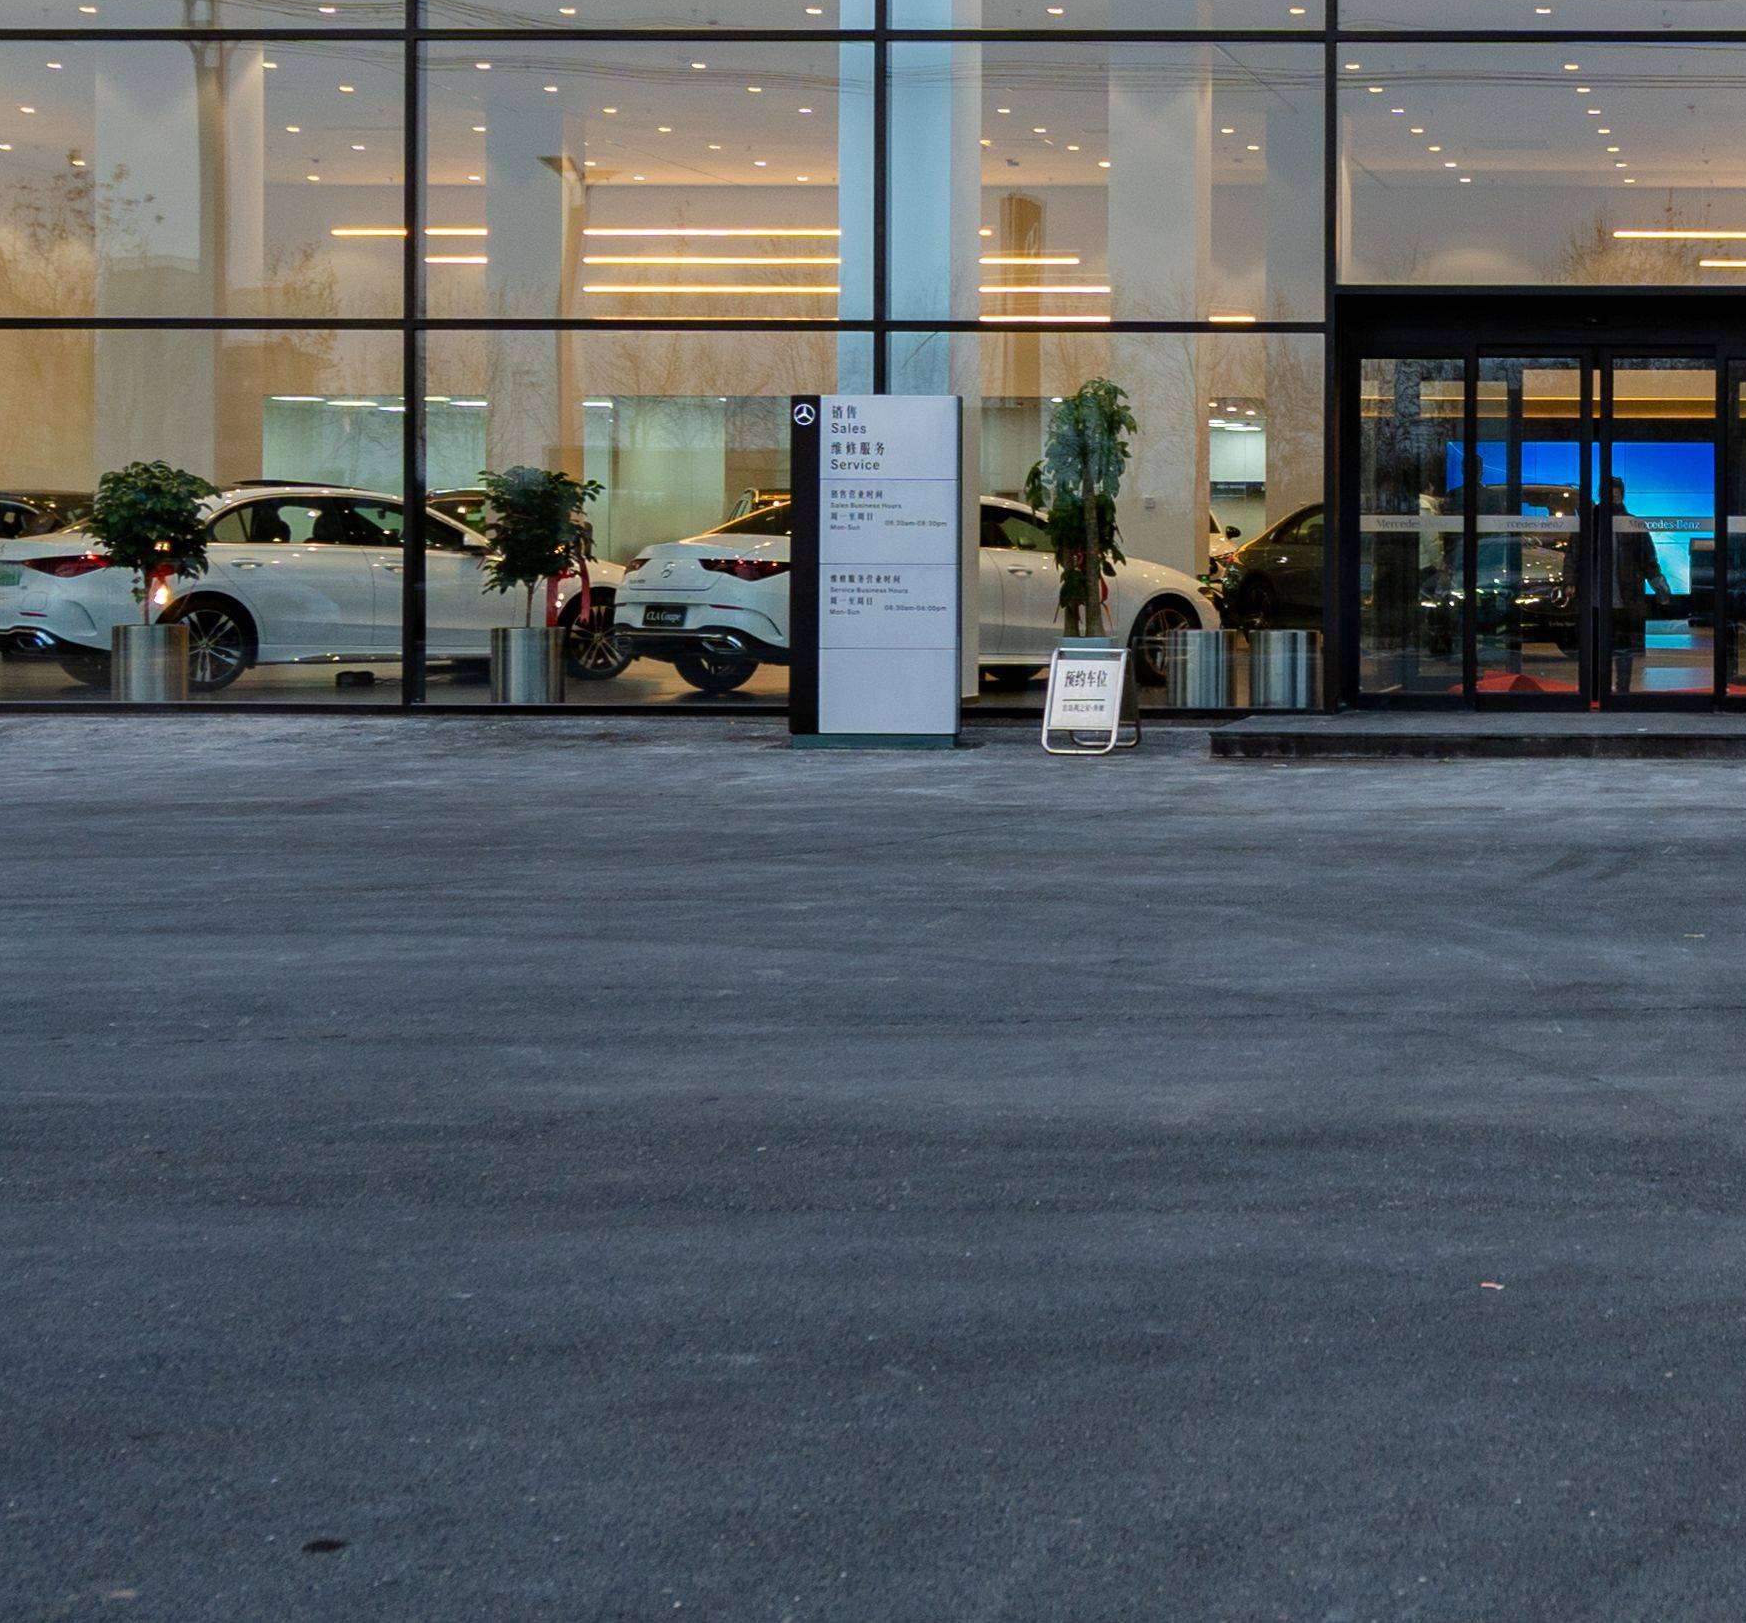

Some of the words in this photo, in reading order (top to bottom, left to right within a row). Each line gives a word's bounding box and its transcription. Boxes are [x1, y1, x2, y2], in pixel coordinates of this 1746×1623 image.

[832, 405, 857, 419] 销售
[831, 422, 867, 434] Sales
[831, 441, 885, 456] 维修服务
[831, 459, 880, 470] Service
[831, 490, 883, 499] 销售营业时间
[1064, 670, 1109, 688] 预约车位
